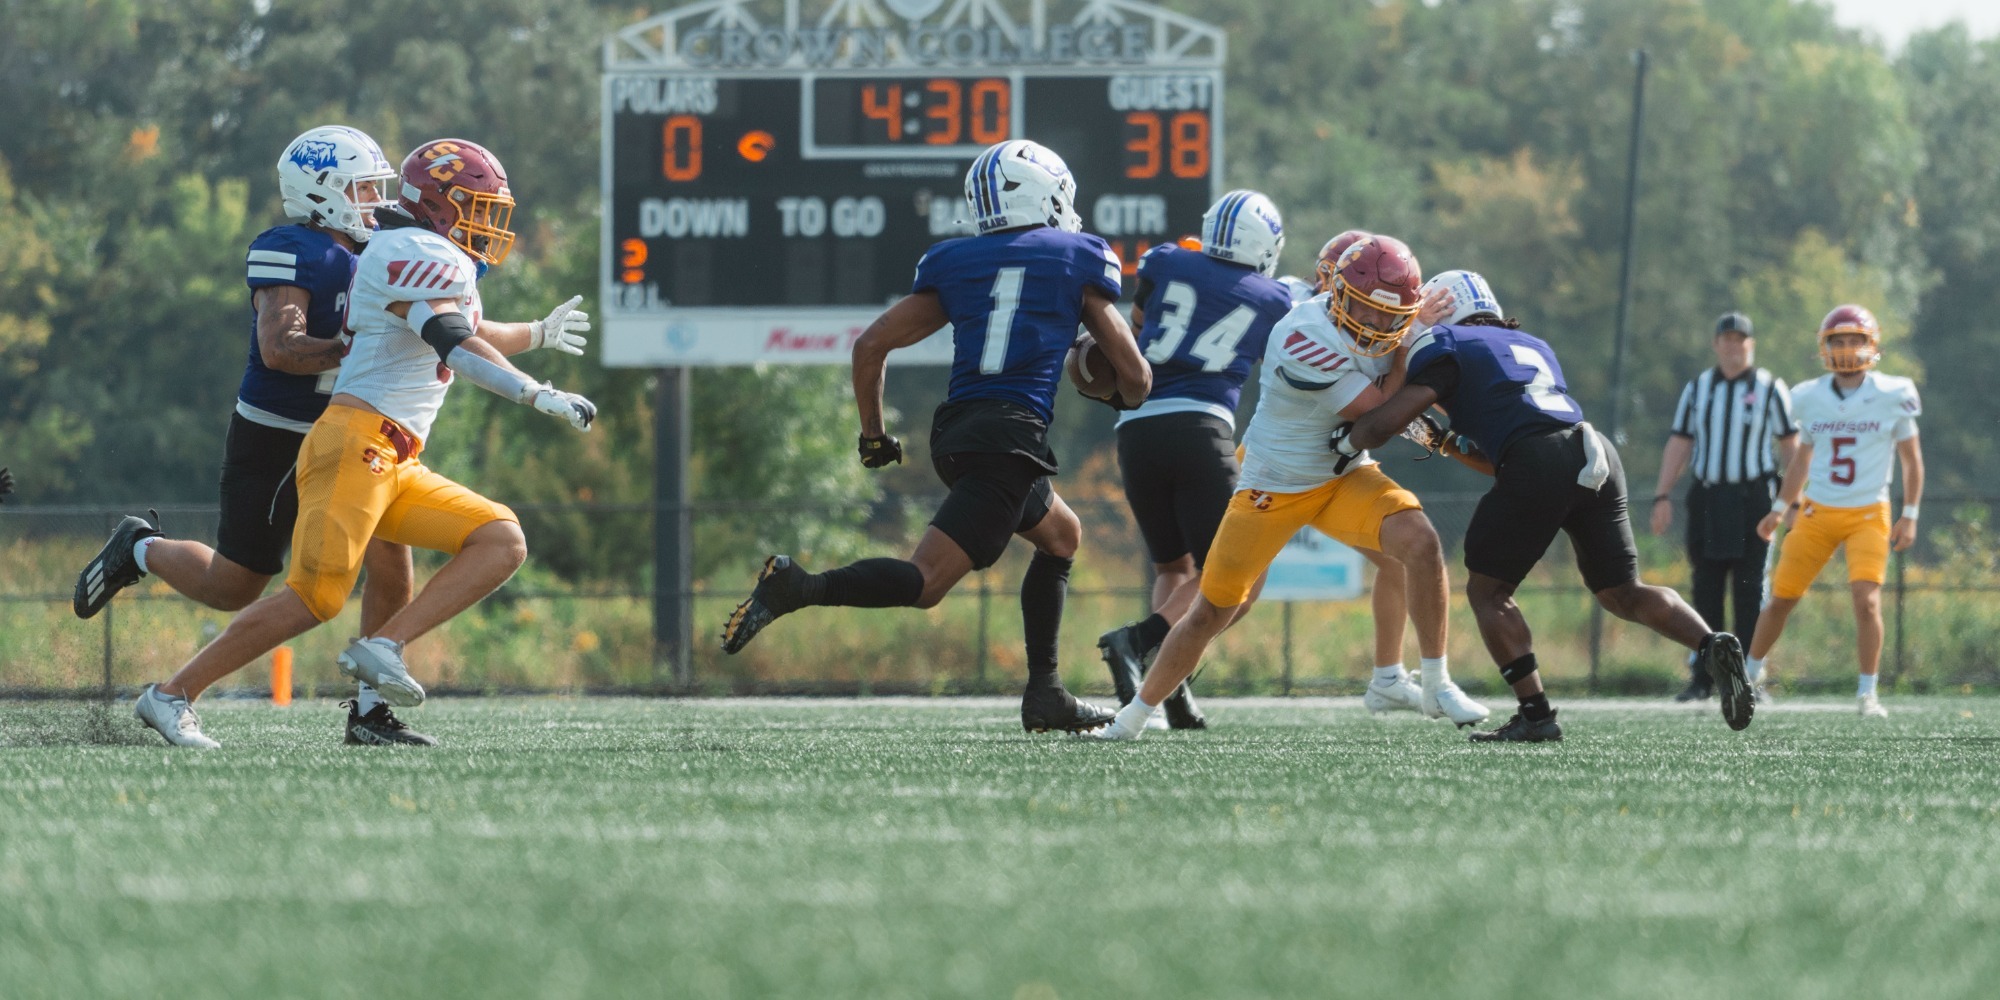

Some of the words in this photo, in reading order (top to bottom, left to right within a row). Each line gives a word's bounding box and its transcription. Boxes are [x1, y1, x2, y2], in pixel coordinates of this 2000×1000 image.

[680, 27, 896, 67] CROWN
[907, 24, 1147, 65] COLLEGE
[611, 76, 718, 114] POLARS
[861, 79, 1011, 145] 4:30
[1108, 77, 1212, 111] GUEST
[663, 114, 702, 182] 0
[1124, 111, 1210, 179] 38
[639, 197, 748, 237] DOWN
[776, 197, 827, 237] TO
[832, 197, 886, 237] GO
[978, 217, 1008, 232] POLARS
[1093, 194, 1167, 236] QTR
[1209, 247, 1234, 259] POLARS
[980, 267, 1026, 375] 1
[1144, 281, 1257, 372] 34
[1510, 344, 1575, 413] 2
[1810, 421, 1880, 434] SIMPSON
[1829, 436, 1857, 487] 5
